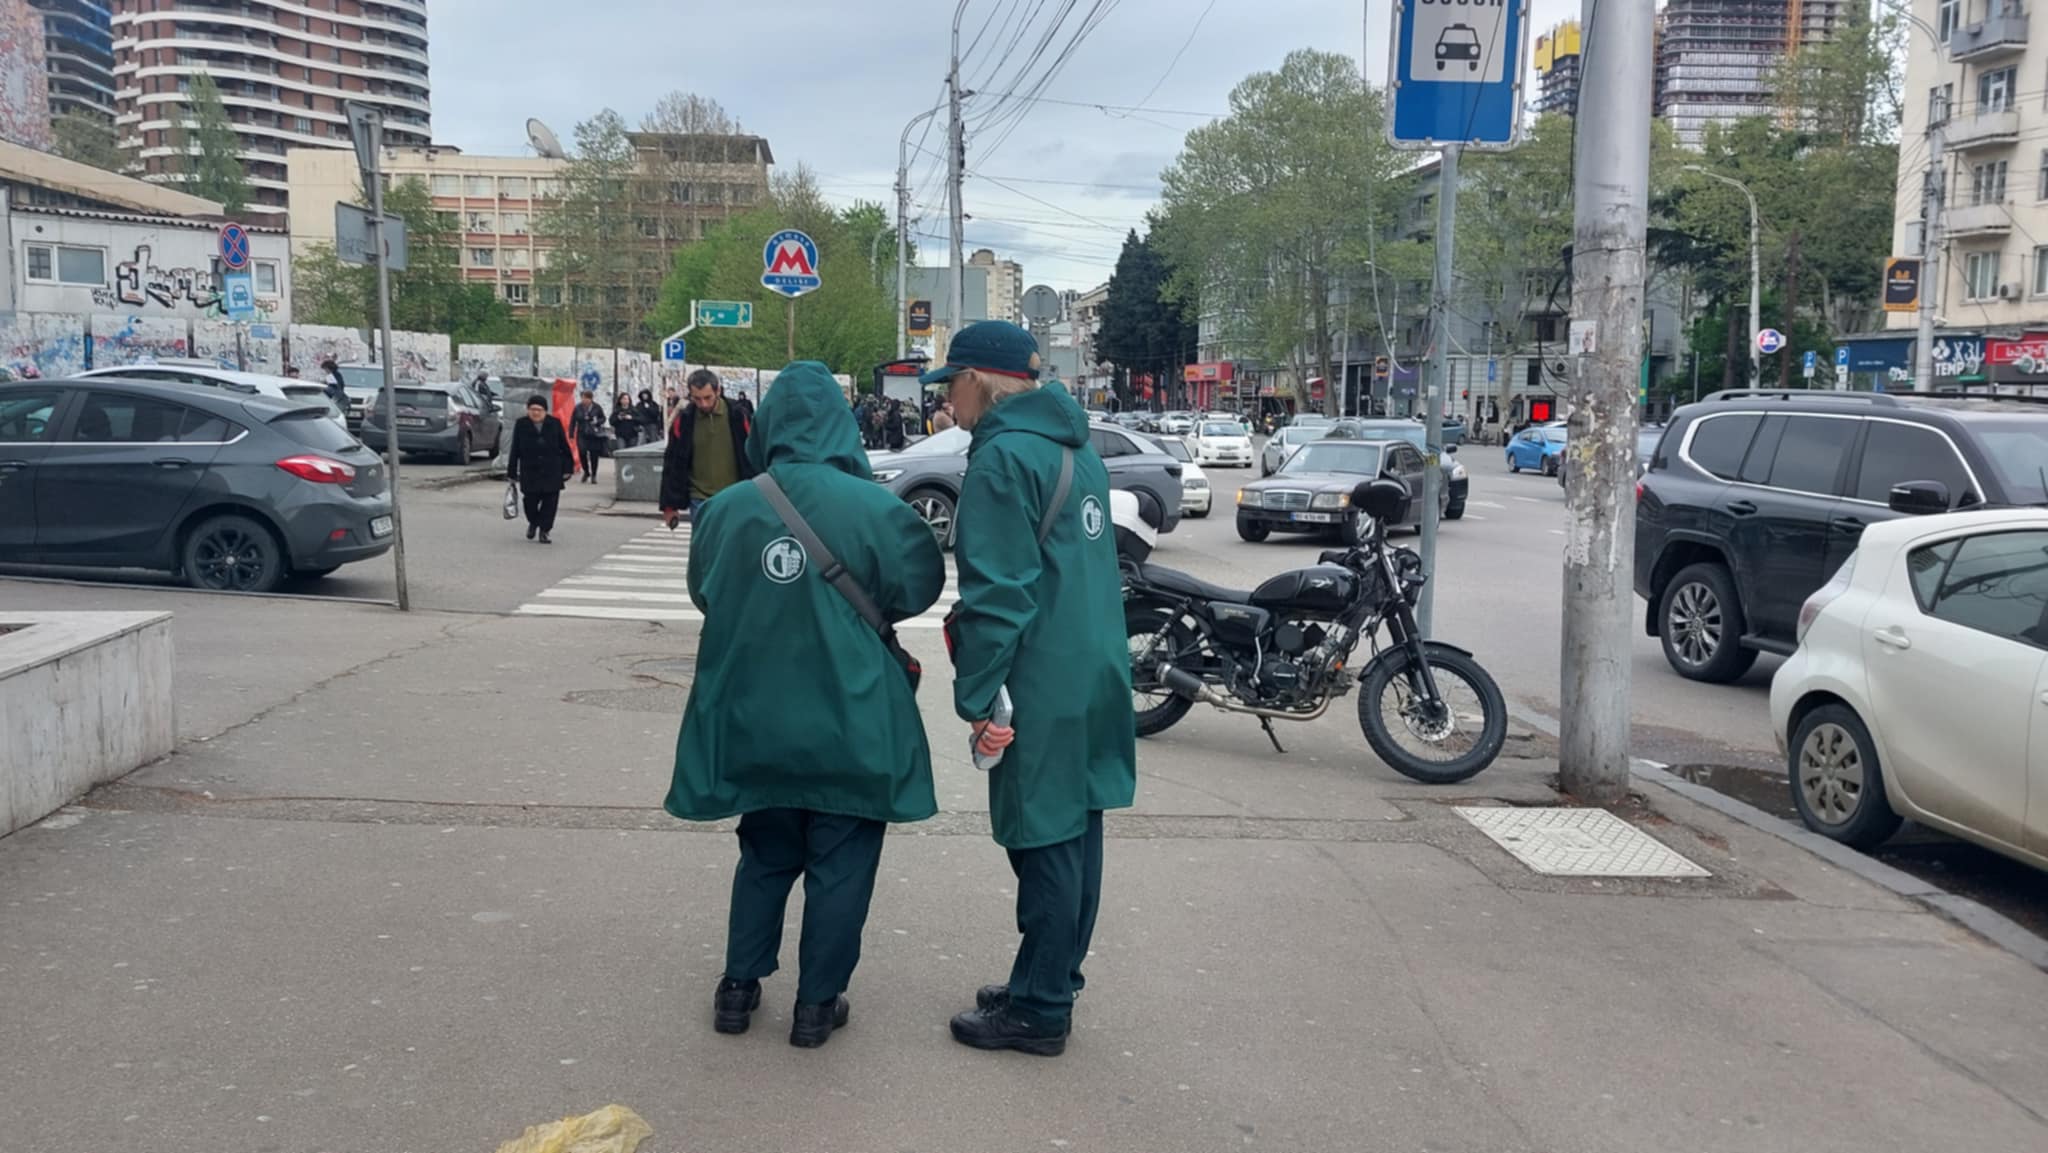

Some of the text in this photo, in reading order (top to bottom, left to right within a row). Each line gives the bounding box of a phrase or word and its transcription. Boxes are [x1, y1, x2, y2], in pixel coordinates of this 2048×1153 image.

[769, 246, 814, 274] M
[670, 343, 681, 358] P
[1839, 349, 1847, 365] P
